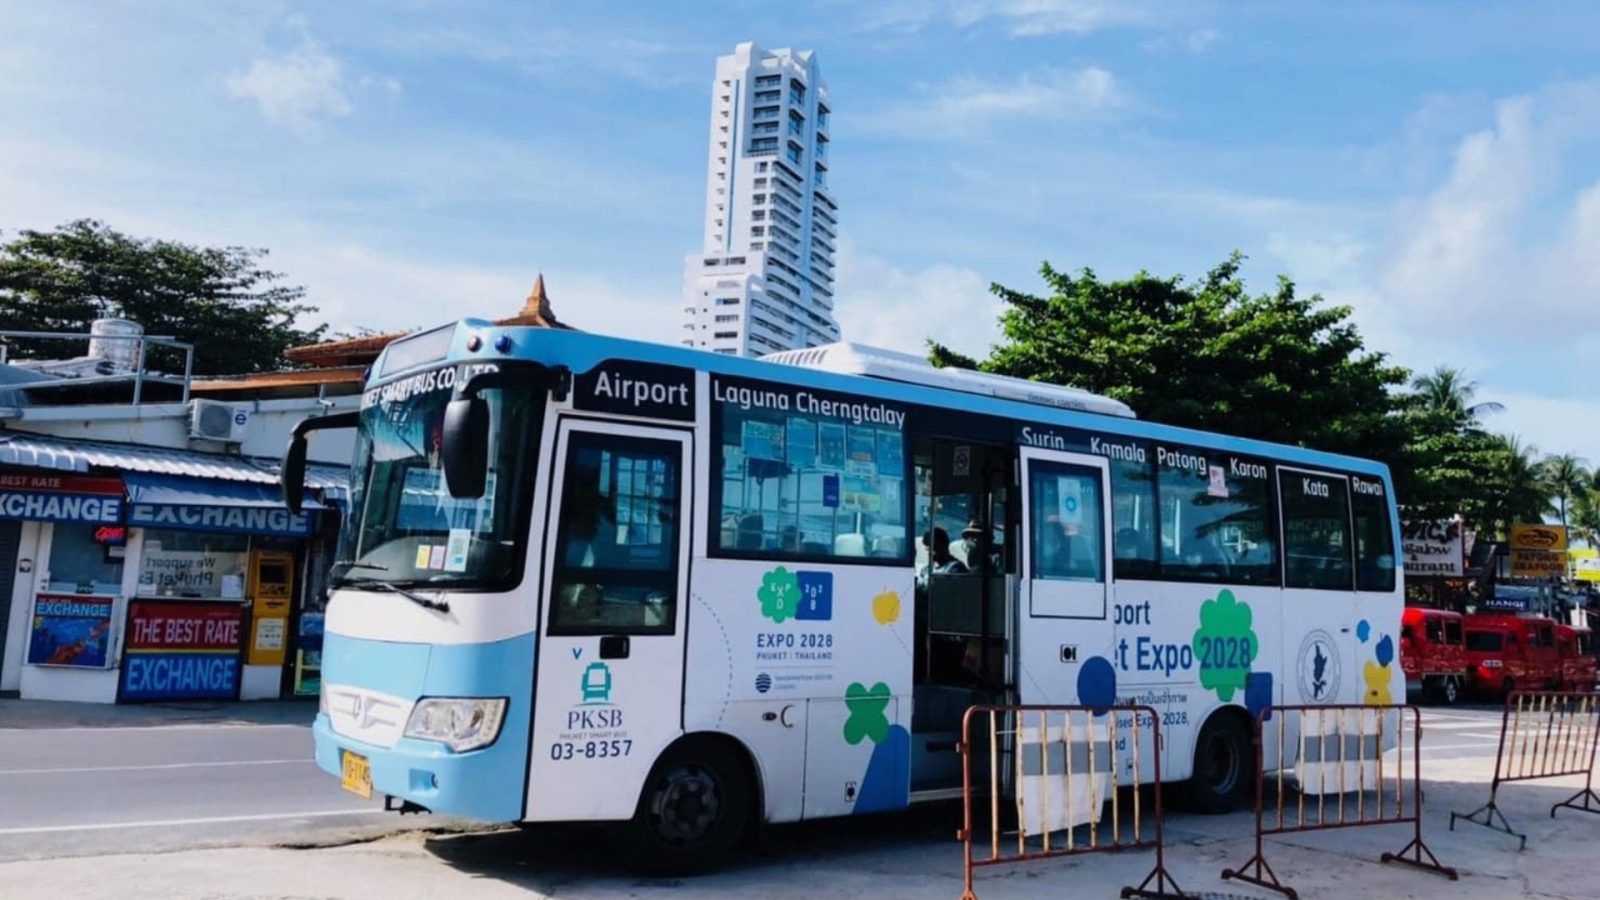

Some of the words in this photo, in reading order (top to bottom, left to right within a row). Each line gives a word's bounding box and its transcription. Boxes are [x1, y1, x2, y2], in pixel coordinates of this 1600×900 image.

[381, 377, 417, 402] SMART
[413, 371, 437, 396] BUS
[594, 371, 690, 406] Airport
[713, 380, 790, 411] Laguna
[796, 392, 906, 429] Cherngtalay
[1022, 427, 1065, 450] Surin
[1090, 437, 1146, 464] Kamala
[1156, 446, 1207, 476] Patong
[1230, 457, 1267, 480] Karon
[1, 475, 27, 486] BEST
[32, 477, 61, 488] RATE
[1303, 477, 1329, 498] Kata
[1352, 476, 1384, 497] Rawai
[133, 505, 308, 532] EXCHANGE
[36, 602, 109, 616] EXCHANGE
[133, 618, 162, 644] THE
[165, 618, 201, 645] BEST
[205, 620, 240, 645] RATE
[757, 633, 794, 648] EXPO
[800, 633, 833, 648] 2028
[757, 652, 787, 661] PHUKET
[795, 651, 833, 661] THAILAND
[1136, 637, 1193, 677] Expo
[1200, 637, 1251, 670] 2028
[126, 657, 237, 692] EXCHANGE
[568, 709, 623, 730] PKSB
[1136, 713, 1153, 730] Exp
[550, 739, 633, 761] 03-8357
